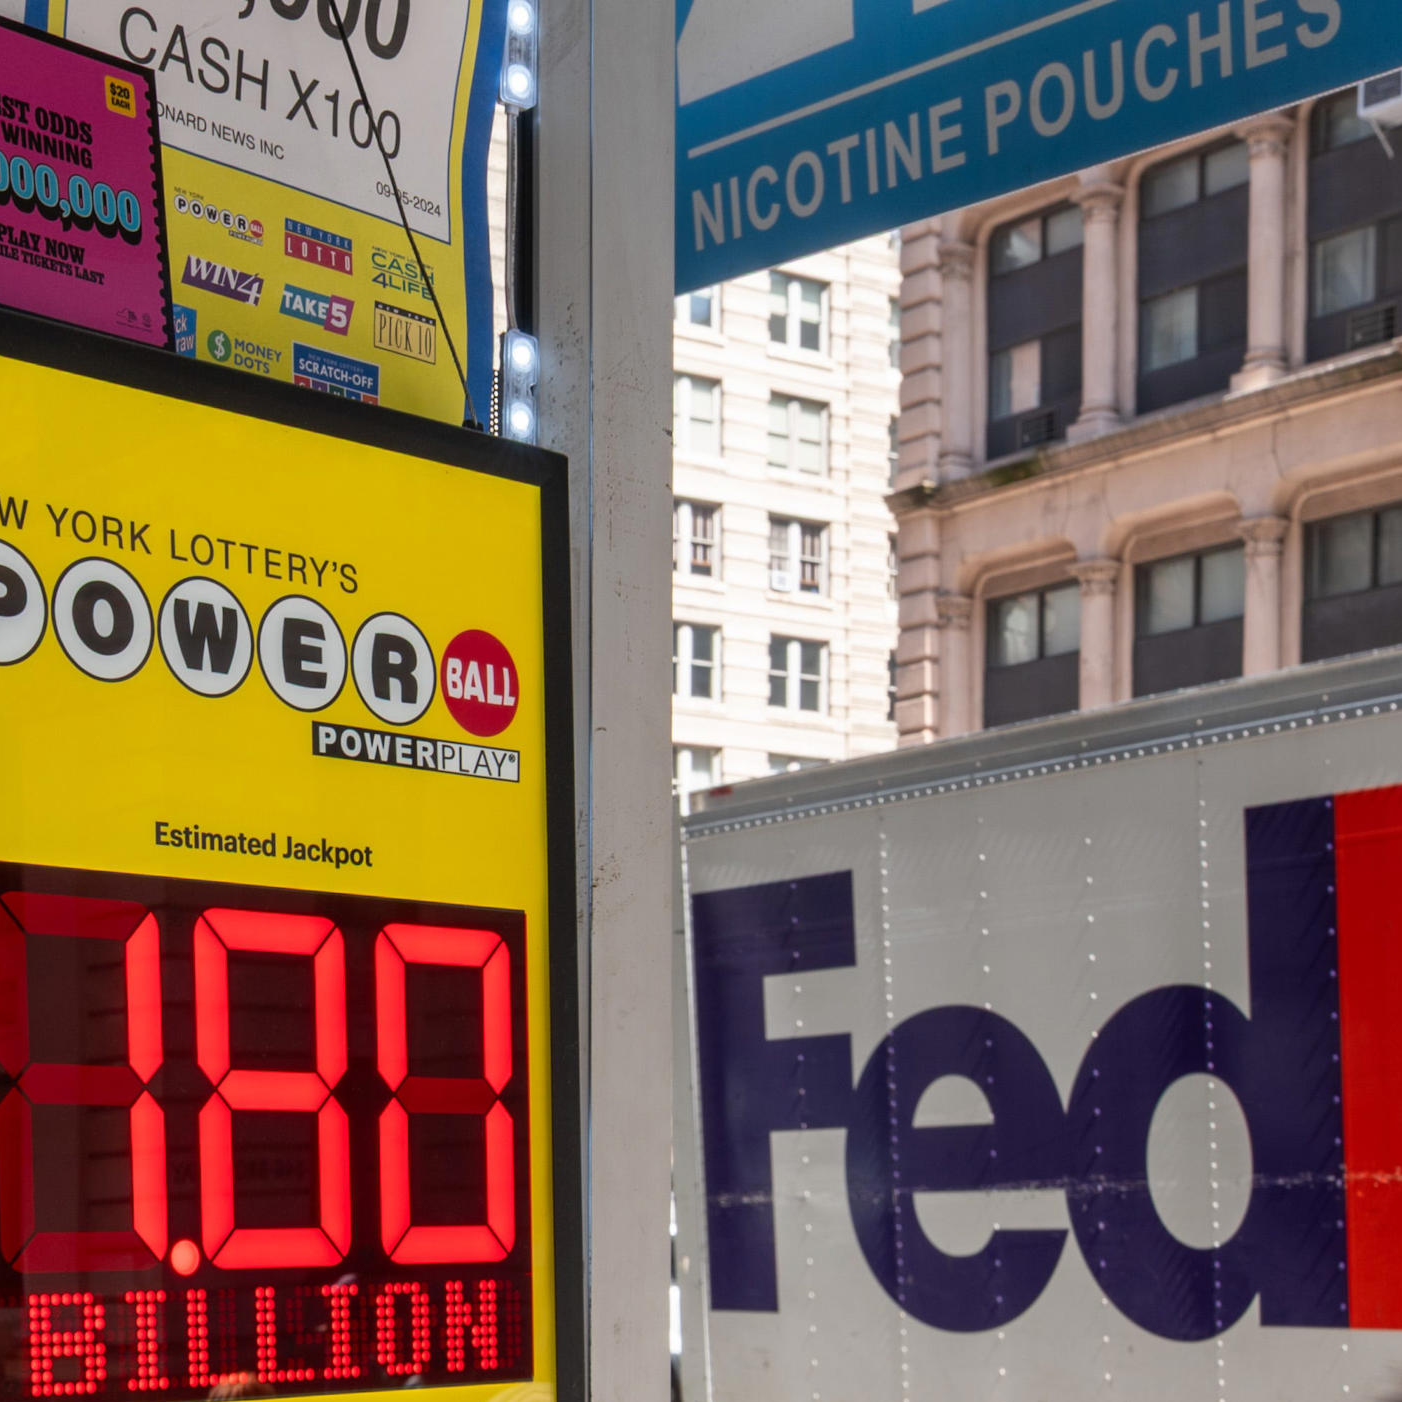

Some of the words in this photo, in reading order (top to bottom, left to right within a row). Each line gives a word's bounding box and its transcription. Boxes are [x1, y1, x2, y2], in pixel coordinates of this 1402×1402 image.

[120, 6, 269, 111] CASH
[286, 69, 402, 160] X100
[1, 121, 93, 169] WINNING
[35, 108, 93, 145] ODDS
[692, 98, 966, 252] NICOTINE
[984, 0, 1342, 156] POUCHES
[44, 236, 86, 266] NOW
[234, 338, 282, 364] MONEY
[234, 354, 271, 374] DOTS
[298, 358, 374, 390] SCRATCH-OFF
[46, 503, 152, 555] YORK
[169, 528, 361, 595] LOTTERY'S
[153, 820, 278, 859] Estimated
[281, 833, 374, 869] Jackpot
[28, 1279, 500, 1397] BILLION
